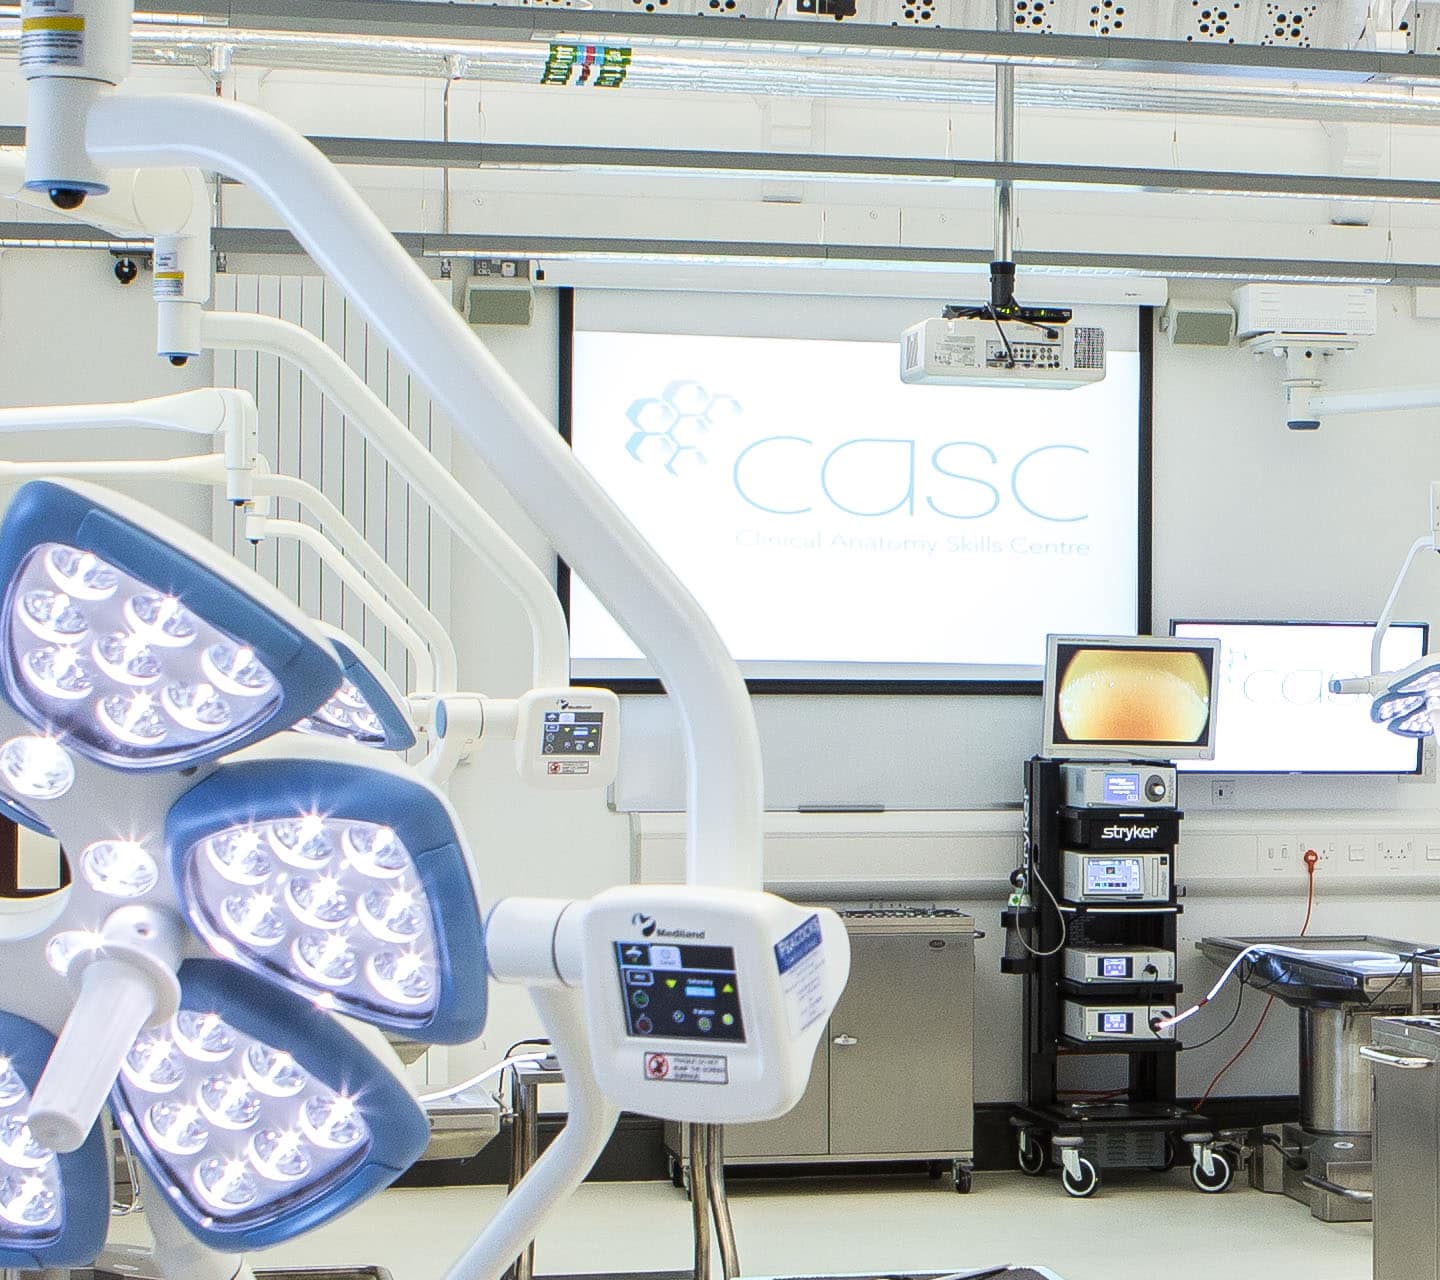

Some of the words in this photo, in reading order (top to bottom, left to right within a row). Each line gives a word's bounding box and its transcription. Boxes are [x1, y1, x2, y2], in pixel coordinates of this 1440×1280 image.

[733, 435, 1090, 522] casc
[946, 535, 1003, 554] Skills
[1009, 535, 1091, 557] Centre
[1101, 824, 1159, 841] stryker
